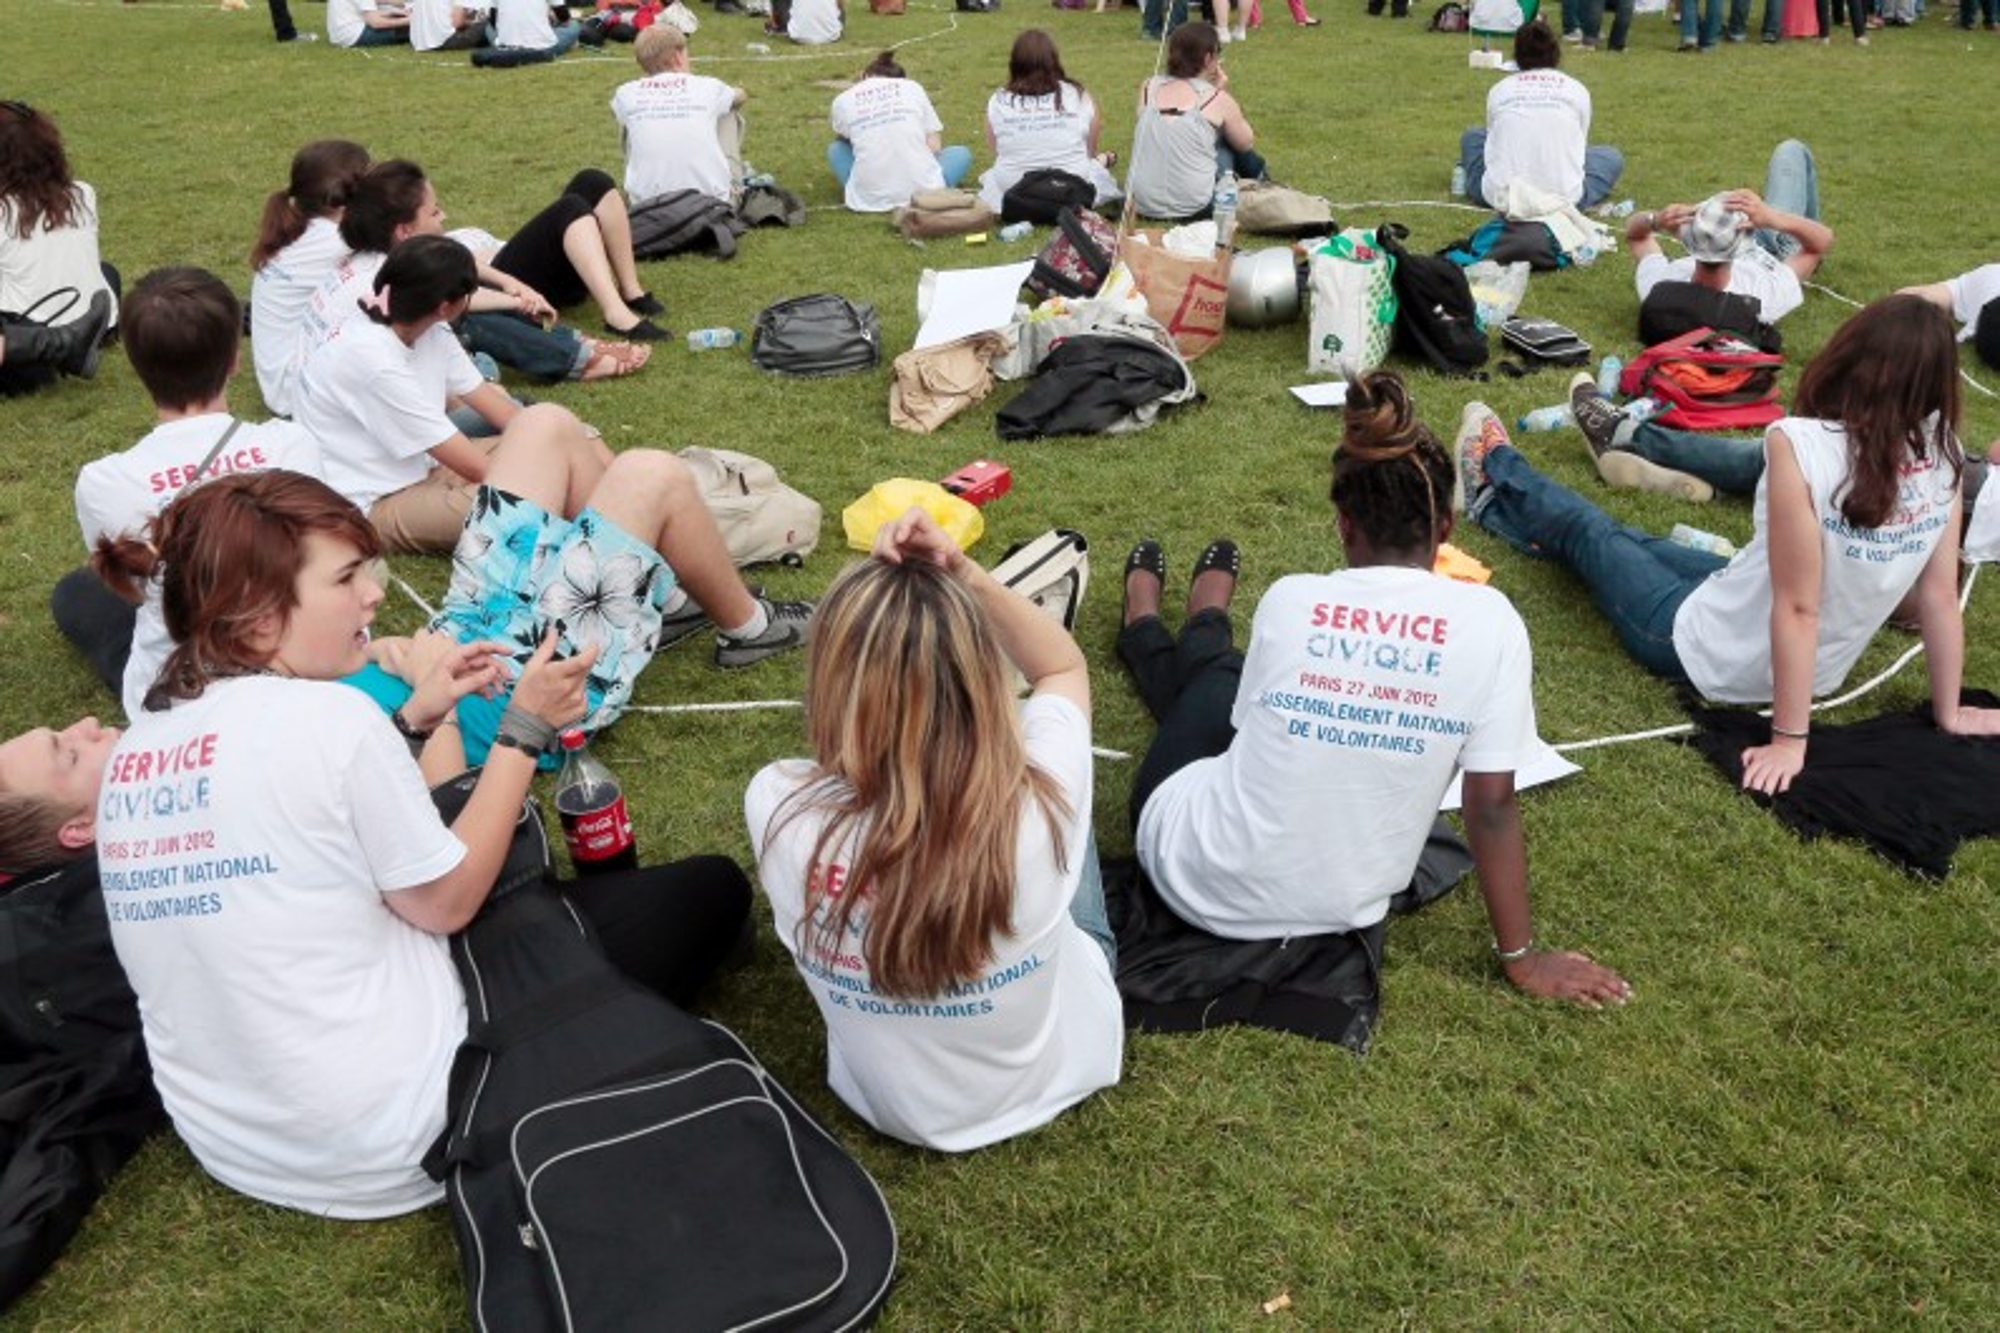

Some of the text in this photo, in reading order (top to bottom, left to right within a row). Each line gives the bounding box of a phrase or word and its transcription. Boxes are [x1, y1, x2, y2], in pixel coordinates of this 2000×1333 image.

[1311, 603, 1449, 645] SERVICE
[1306, 633, 1443, 677] CIVIQUE
[1300, 672, 1438, 708] PARIS 27 JUIN 2012
[1288, 719, 1425, 755] DE VOLONTAIRES
[110, 734, 219, 784] SERVICE
[104, 776, 210, 821] CIVIQUE
[132, 840, 149, 858] 27
[183, 829, 215, 851] 2012
[183, 853, 278, 885] NATIONAL
[123, 892, 223, 922] VOLONTAIRES
[855, 997, 994, 1018] VOLONTAIRES
